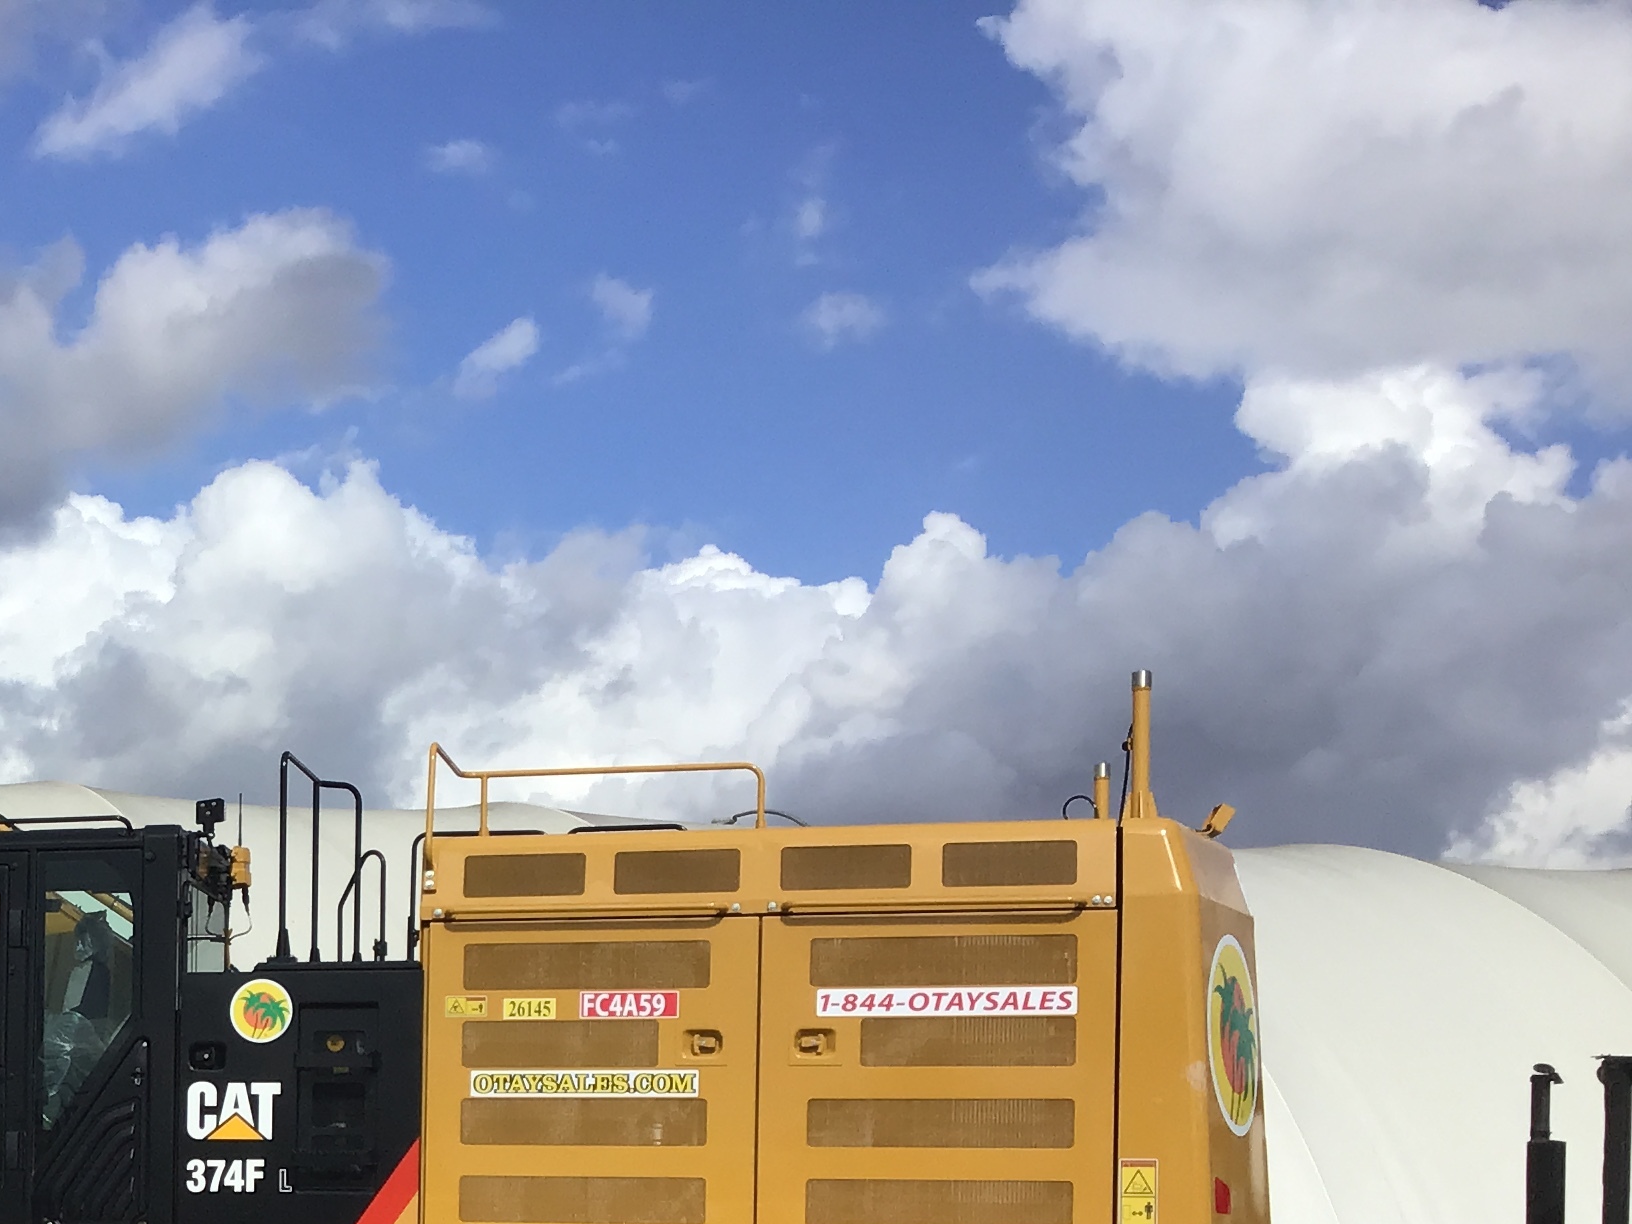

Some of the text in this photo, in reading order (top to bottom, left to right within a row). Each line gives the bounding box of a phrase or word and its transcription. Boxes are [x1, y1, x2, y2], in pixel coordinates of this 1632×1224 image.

[508, 1000, 551, 1017] 26145
[582, 993, 666, 1017] FC4A59
[820, 991, 1073, 1012] 1-844-OTAYSALES
[473, 1073, 696, 1094] OTAYSALES.COM
[187, 1081, 282, 1140] CAT
[186, 1159, 293, 1193] 374F L
